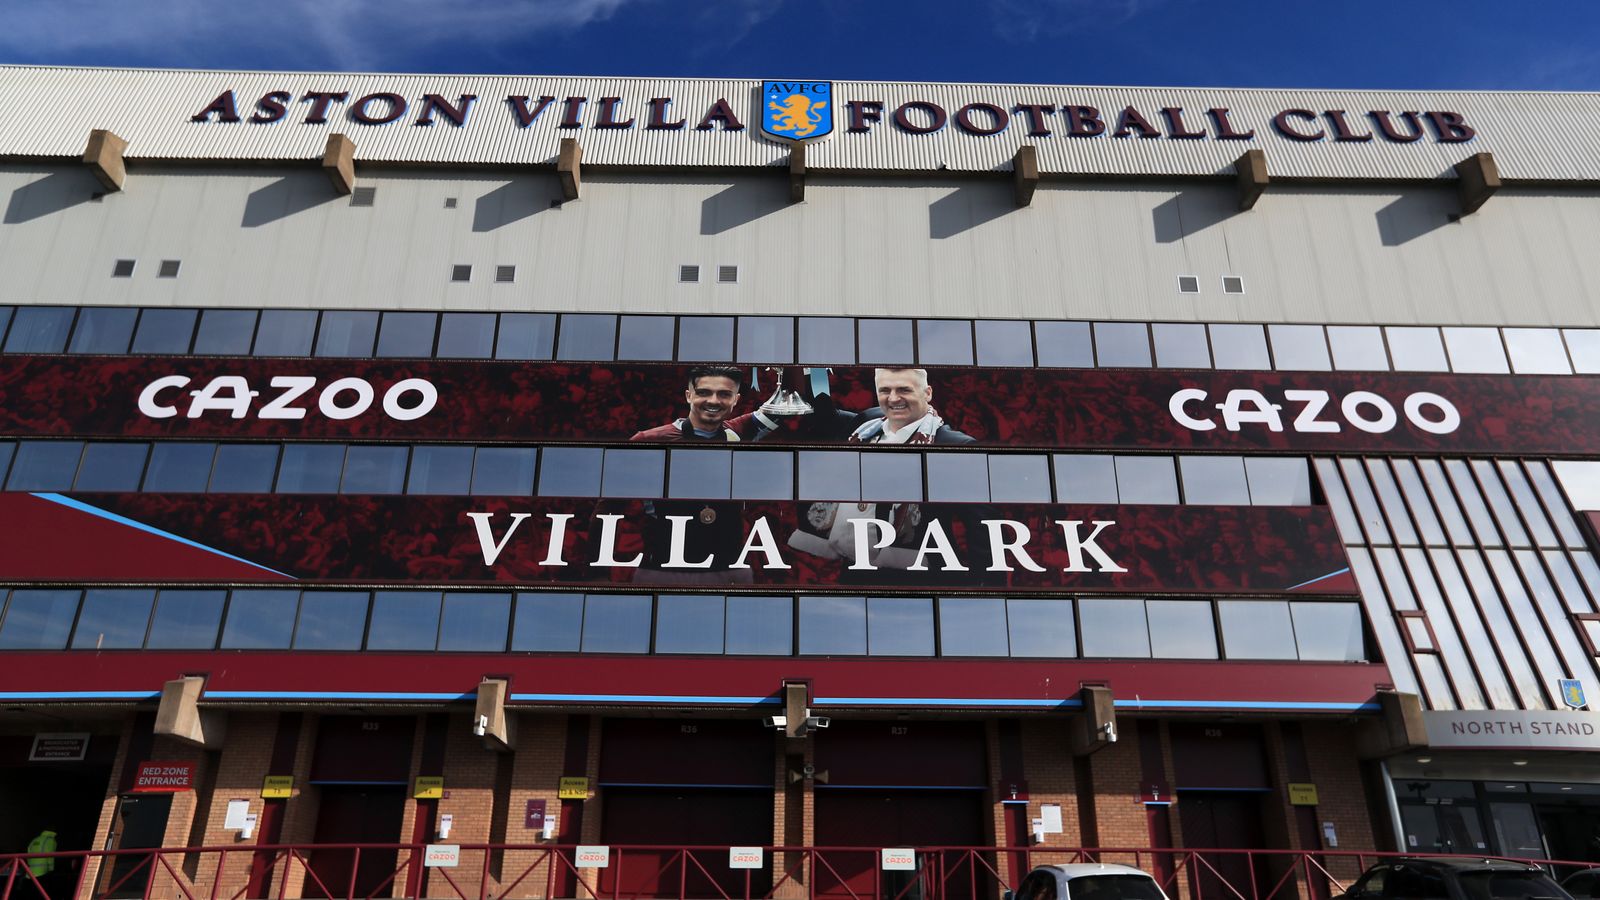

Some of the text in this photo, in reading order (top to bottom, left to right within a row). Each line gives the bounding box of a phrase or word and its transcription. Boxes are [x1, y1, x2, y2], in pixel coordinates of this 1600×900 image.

[768, 83, 827, 94] AVFC
[190, 89, 1476, 144] ASTON VILLA FOOTBALL CLUB
[137, 374, 438, 421] CAZOO
[1168, 388, 1461, 434] CAZOO
[466, 512, 1129, 573] VILLA PARK
[891, 726, 908, 735] R37
[1451, 720, 1595, 736] NORTH STAND
[142, 767, 189, 776] RED ZONE
[138, 777, 190, 785] ENTRANCE
[428, 853, 456, 861] CAZOO
[578, 854, 605, 862] CAZOO
[732, 855, 760, 863] CAZOO
[885, 856, 912, 864] CAZOO
